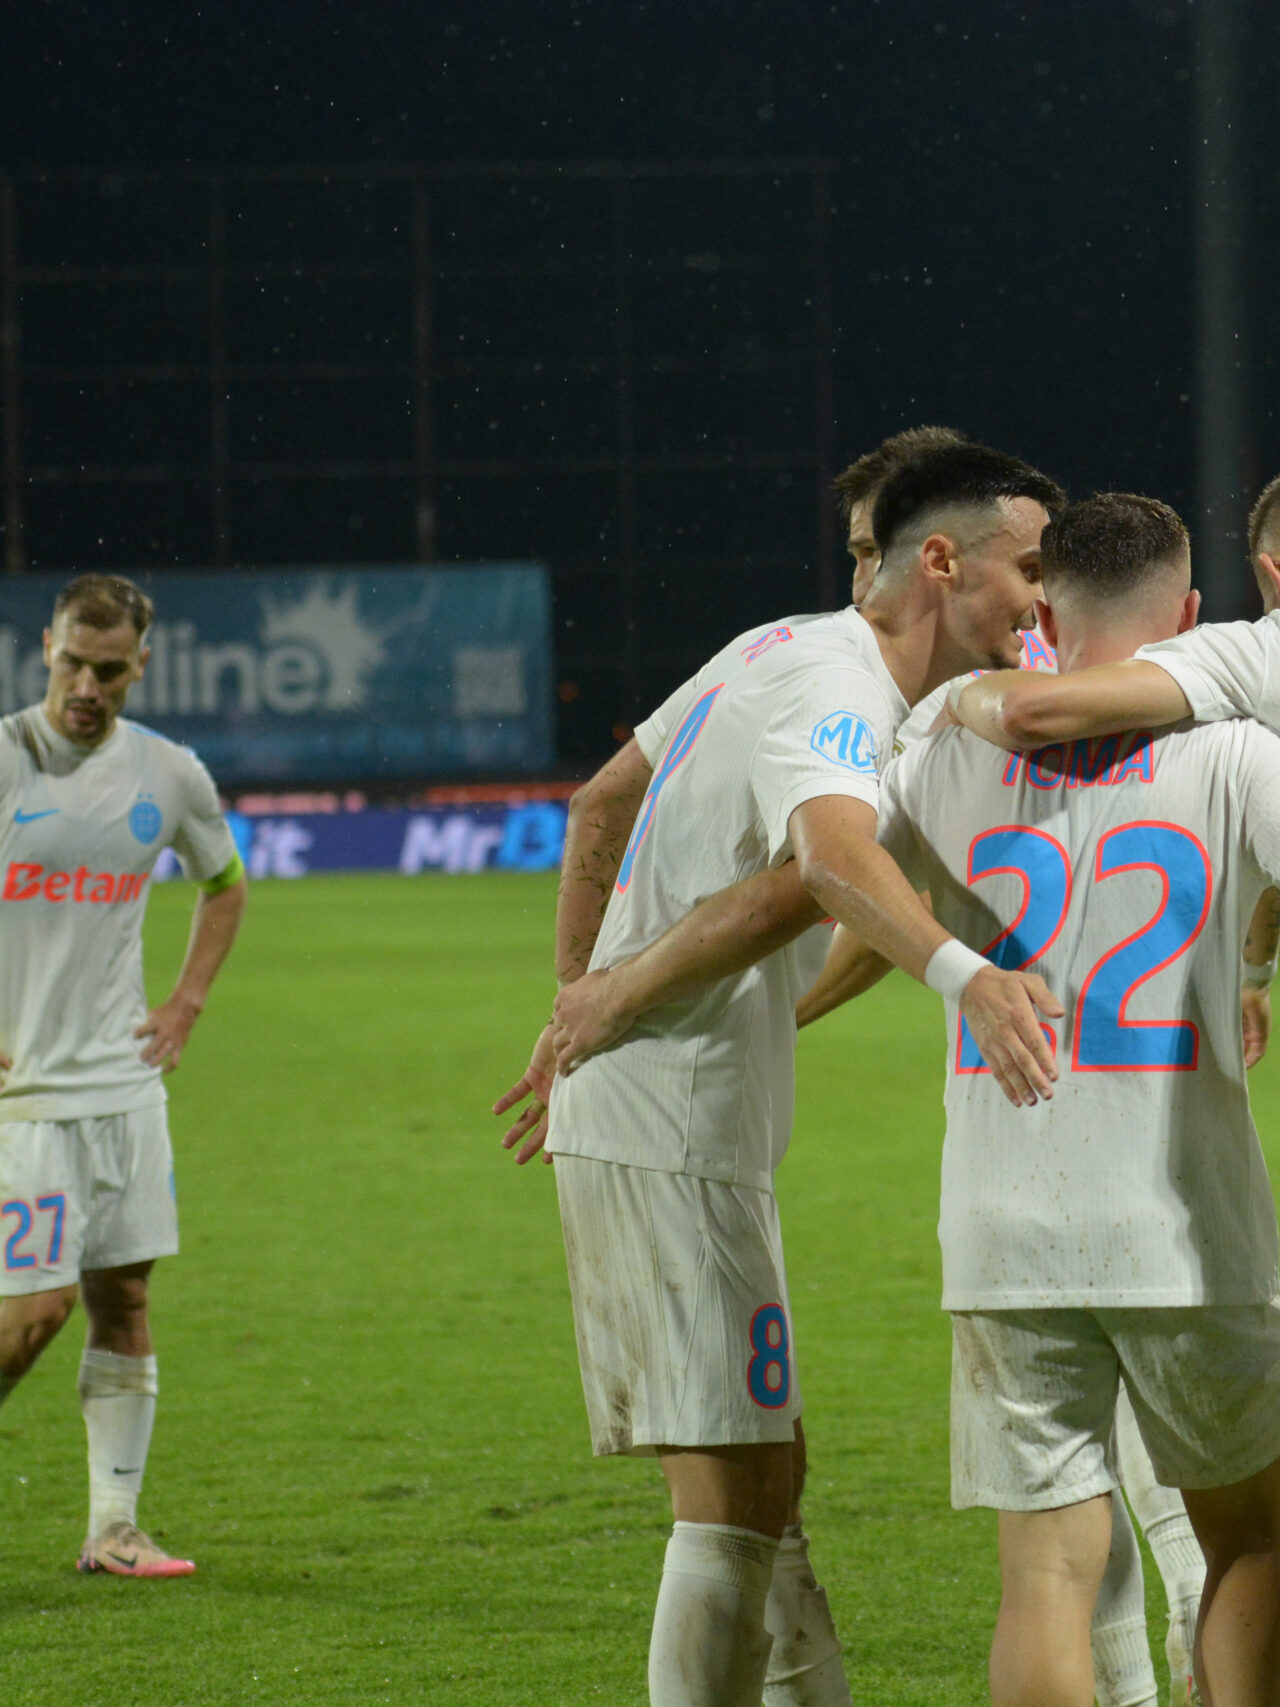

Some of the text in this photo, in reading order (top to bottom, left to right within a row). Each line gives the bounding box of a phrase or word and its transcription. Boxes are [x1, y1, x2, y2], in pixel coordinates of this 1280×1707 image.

[399, 802, 569, 877] MrB
[955, 820, 1213, 1074] 22
[0, 1190, 66, 1272] 27
[747, 1303, 790, 1410] 8
